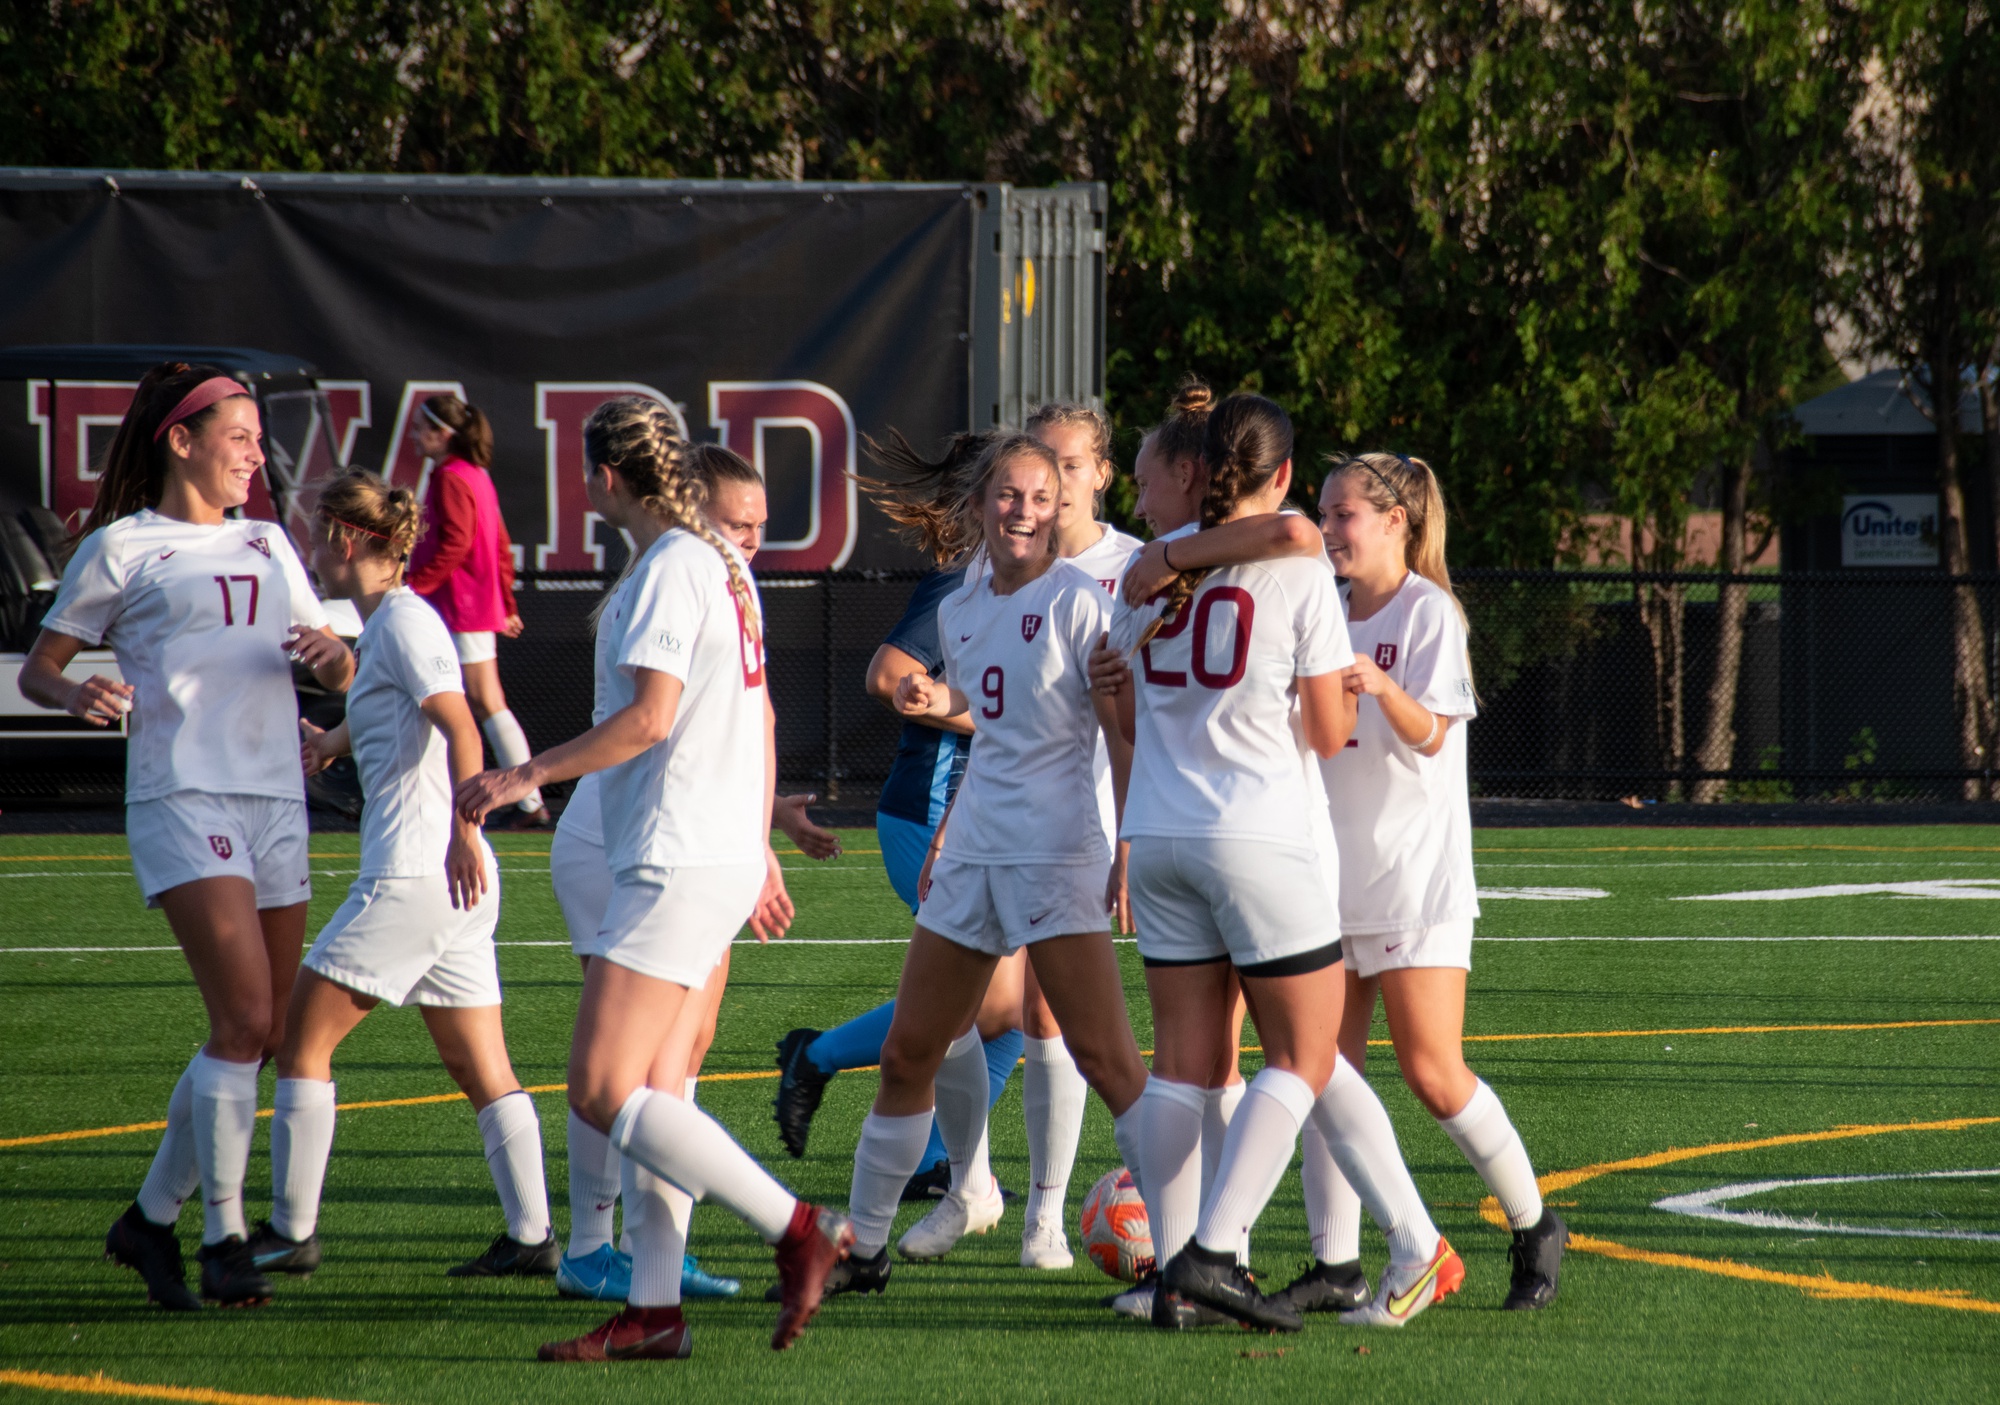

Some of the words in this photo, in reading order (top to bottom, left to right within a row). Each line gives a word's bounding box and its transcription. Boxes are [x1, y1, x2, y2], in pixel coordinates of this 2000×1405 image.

[252, 537, 270, 556] H
[213, 574, 260, 627] 17
[1024, 616, 1038, 635] H
[658, 634, 683, 649] IVY
[1140, 585, 1255, 689] 20
[1377, 646, 1393, 665] H
[981, 666, 1004, 719] 9
[213, 837, 231, 853] H
